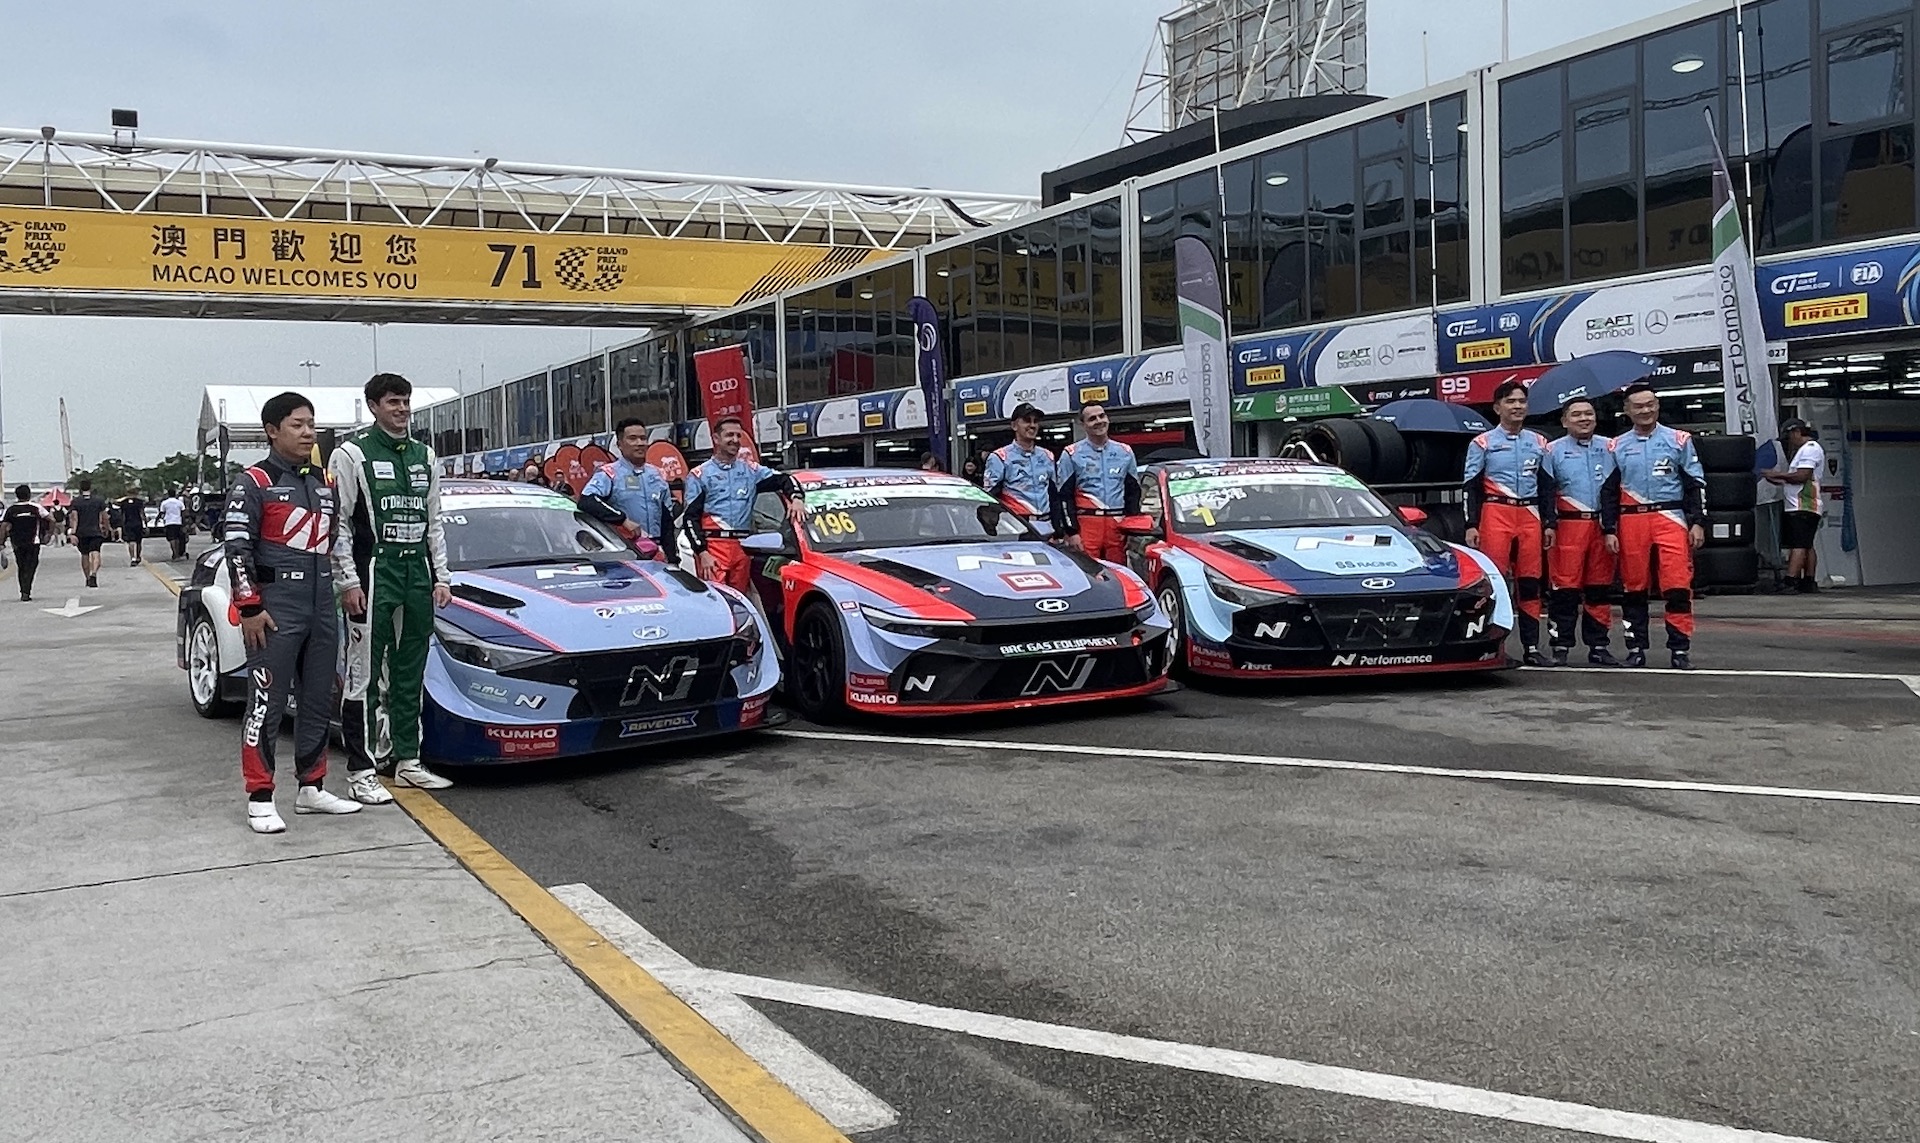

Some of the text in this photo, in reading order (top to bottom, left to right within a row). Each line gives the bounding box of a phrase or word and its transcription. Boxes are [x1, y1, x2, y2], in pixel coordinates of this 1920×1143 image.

[24, 221, 67, 231] GRAND
[24, 232, 52, 241] PRIX
[151, 224, 418, 265] 澳門歡迎您
[24, 242, 66, 252] MACAU
[597, 247, 628, 256] GRAND
[487, 243, 542, 289] 71
[597, 255, 617, 264] PRIX
[596, 264, 628, 273] MACAU
[1853, 265, 1879, 281] FIA
[152, 264, 418, 290] MACAO WELCOMES YOU
[1792, 299, 1860, 321] PIRELLI
[1500, 315, 1519, 330] FIA
[1586, 328, 1635, 341] bamboo
[1275, 346, 1291, 358] FIA
[1461, 342, 1505, 359] PIRELLI
[1249, 368, 1281, 382] PIRELLI
[1441, 376, 1471, 394] 99
[1233, 397, 1255, 412] 77
[826, 497, 889, 511] Azcona
[814, 511, 857, 537] 196
[1191, 507, 1217, 527] 1
[1356, 560, 1398, 568] RACING
[1253, 621, 1291, 639] N
[1465, 615, 1486, 639] N
[1027, 641, 1052, 652] GAS
[1053, 636, 1119, 650] EQUIPMENT
[1192, 644, 1231, 660] KUMHO
[1331, 653, 1433, 667] N Performance
[619, 655, 700, 707] N
[904, 675, 937, 692] N
[1020, 654, 1098, 697] N
[515, 694, 546, 710] N
[850, 691, 898, 704] KUMHO
[628, 715, 690, 732] RAVENOL
[487, 727, 558, 739] KUMHO
